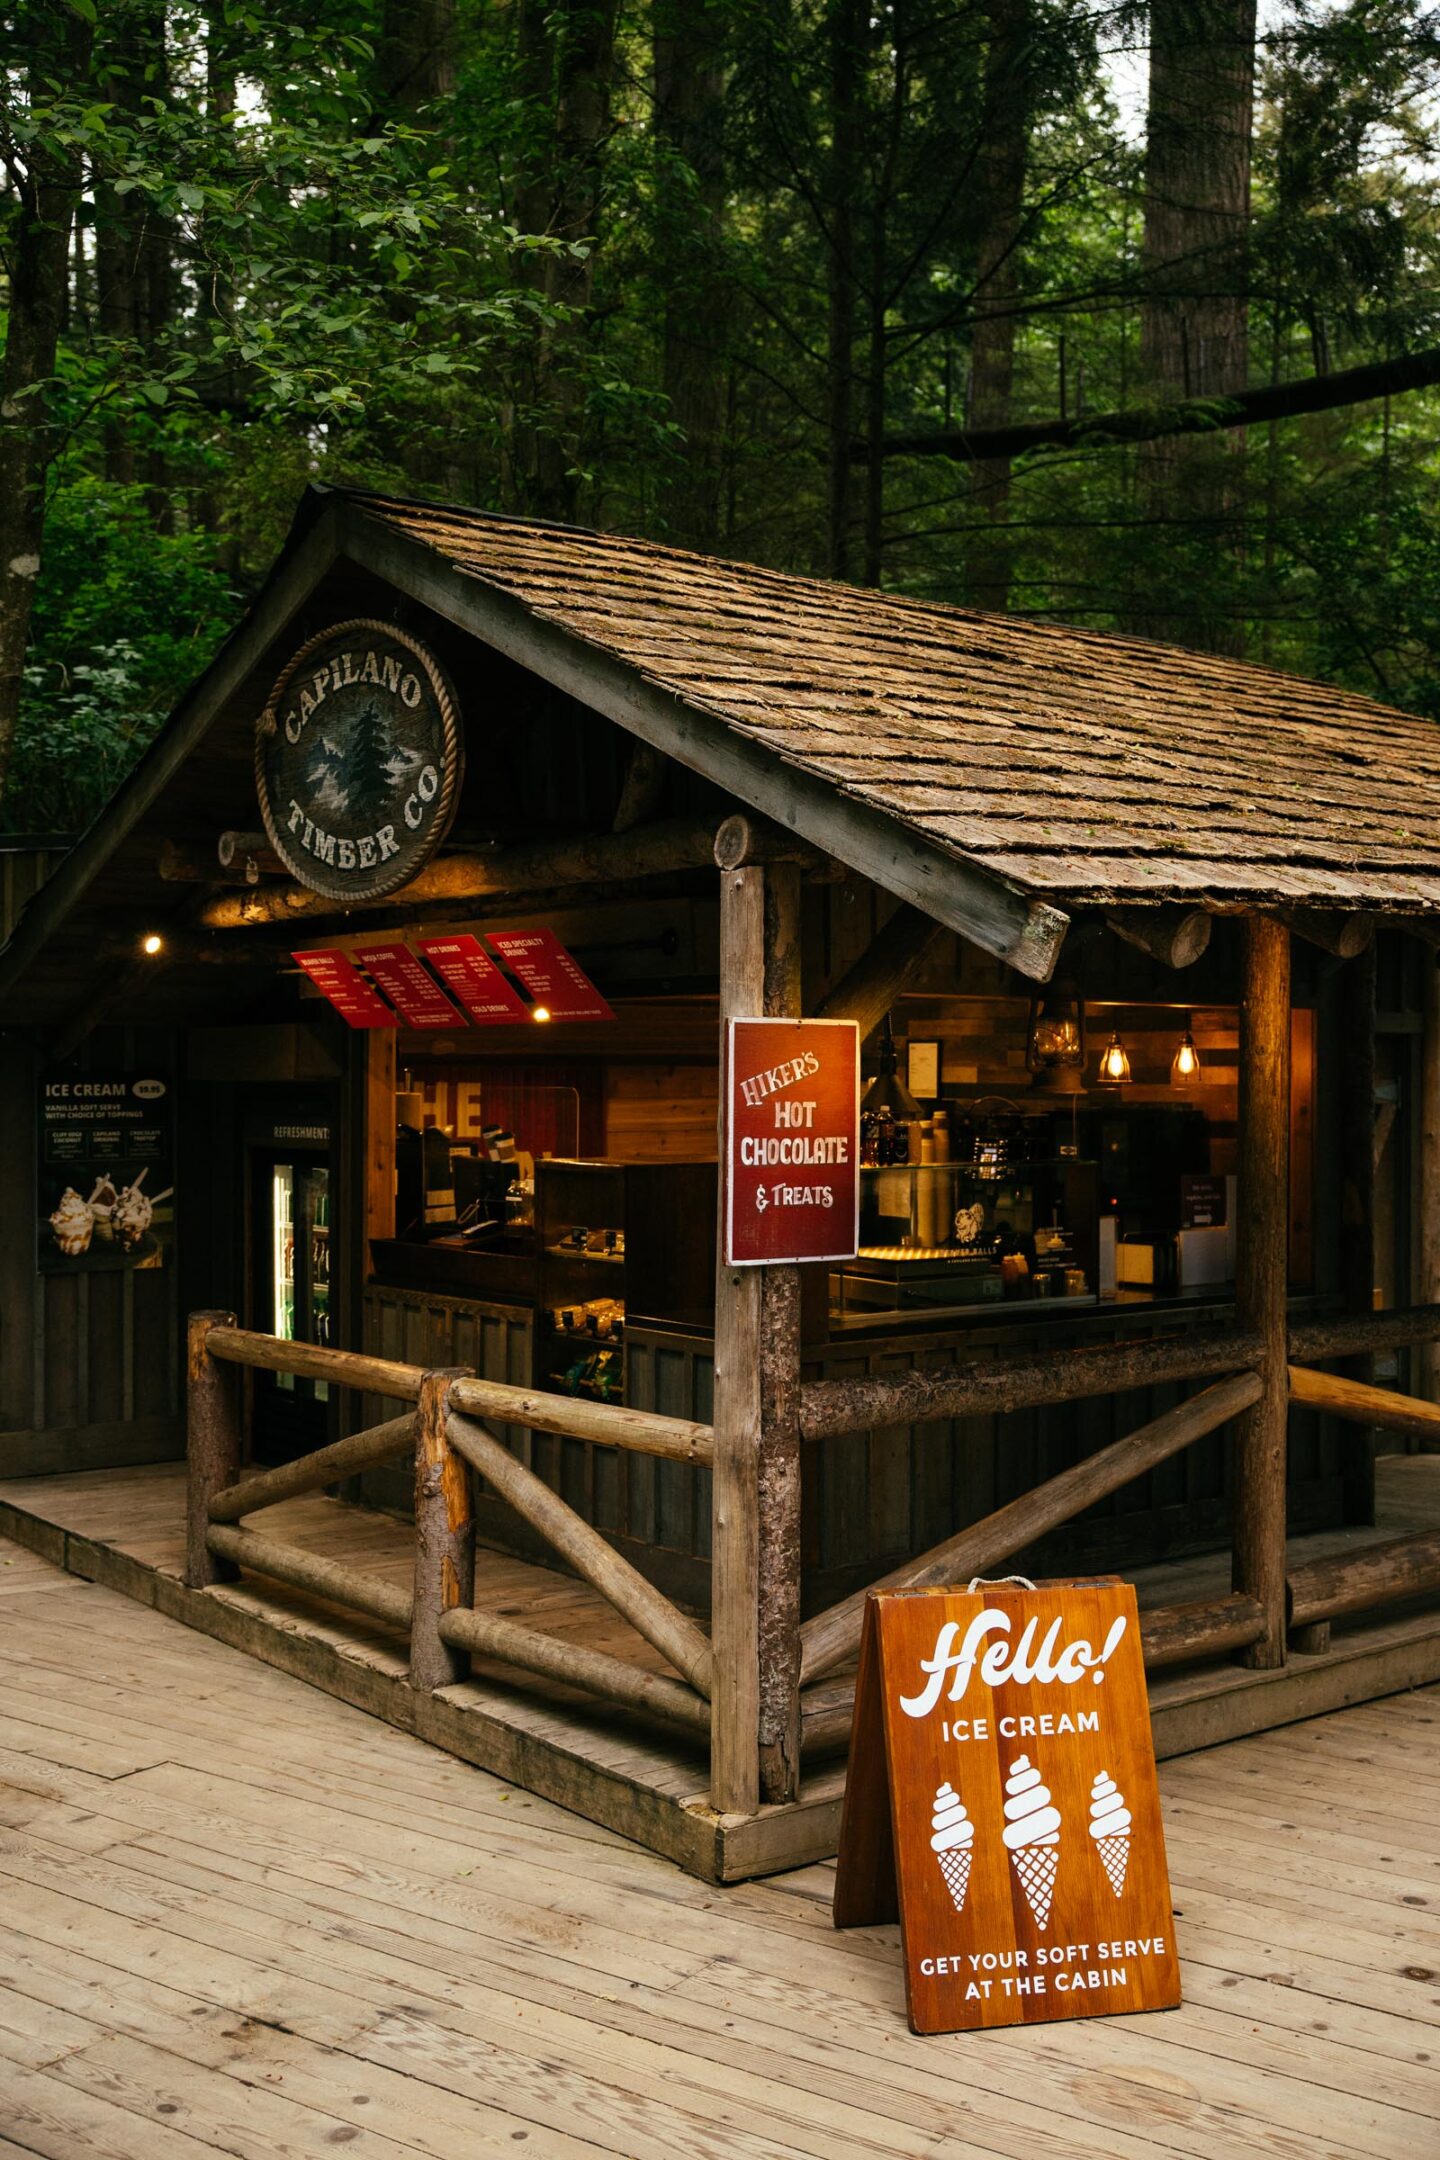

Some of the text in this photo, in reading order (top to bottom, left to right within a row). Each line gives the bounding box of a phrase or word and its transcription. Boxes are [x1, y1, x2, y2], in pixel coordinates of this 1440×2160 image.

[284, 650, 422, 745] CAPILANO
[287, 798, 400, 870] TIMBER
[45, 1083, 126, 1097] ICE CREAM
[740, 1051, 820, 1107] HIKER'S
[44, 1103, 122, 1112] VANILLA SOFT SERVE
[45, 1112, 66, 1120] WITH
[107, 1110, 144, 1119] TOPPINGS
[774, 1101, 816, 1129] HOT
[741, 1136, 848, 1166] CHOCOLATE
[756, 1182, 834, 1213] & TREATS
[899, 1608, 1127, 1718] Hello!
[942, 1711, 1100, 1743] ICE CREAM
[920, 1937, 1166, 1977] GET YOUR SOFT SERVE
[964, 1967, 1128, 2001] AT THE CABIN
